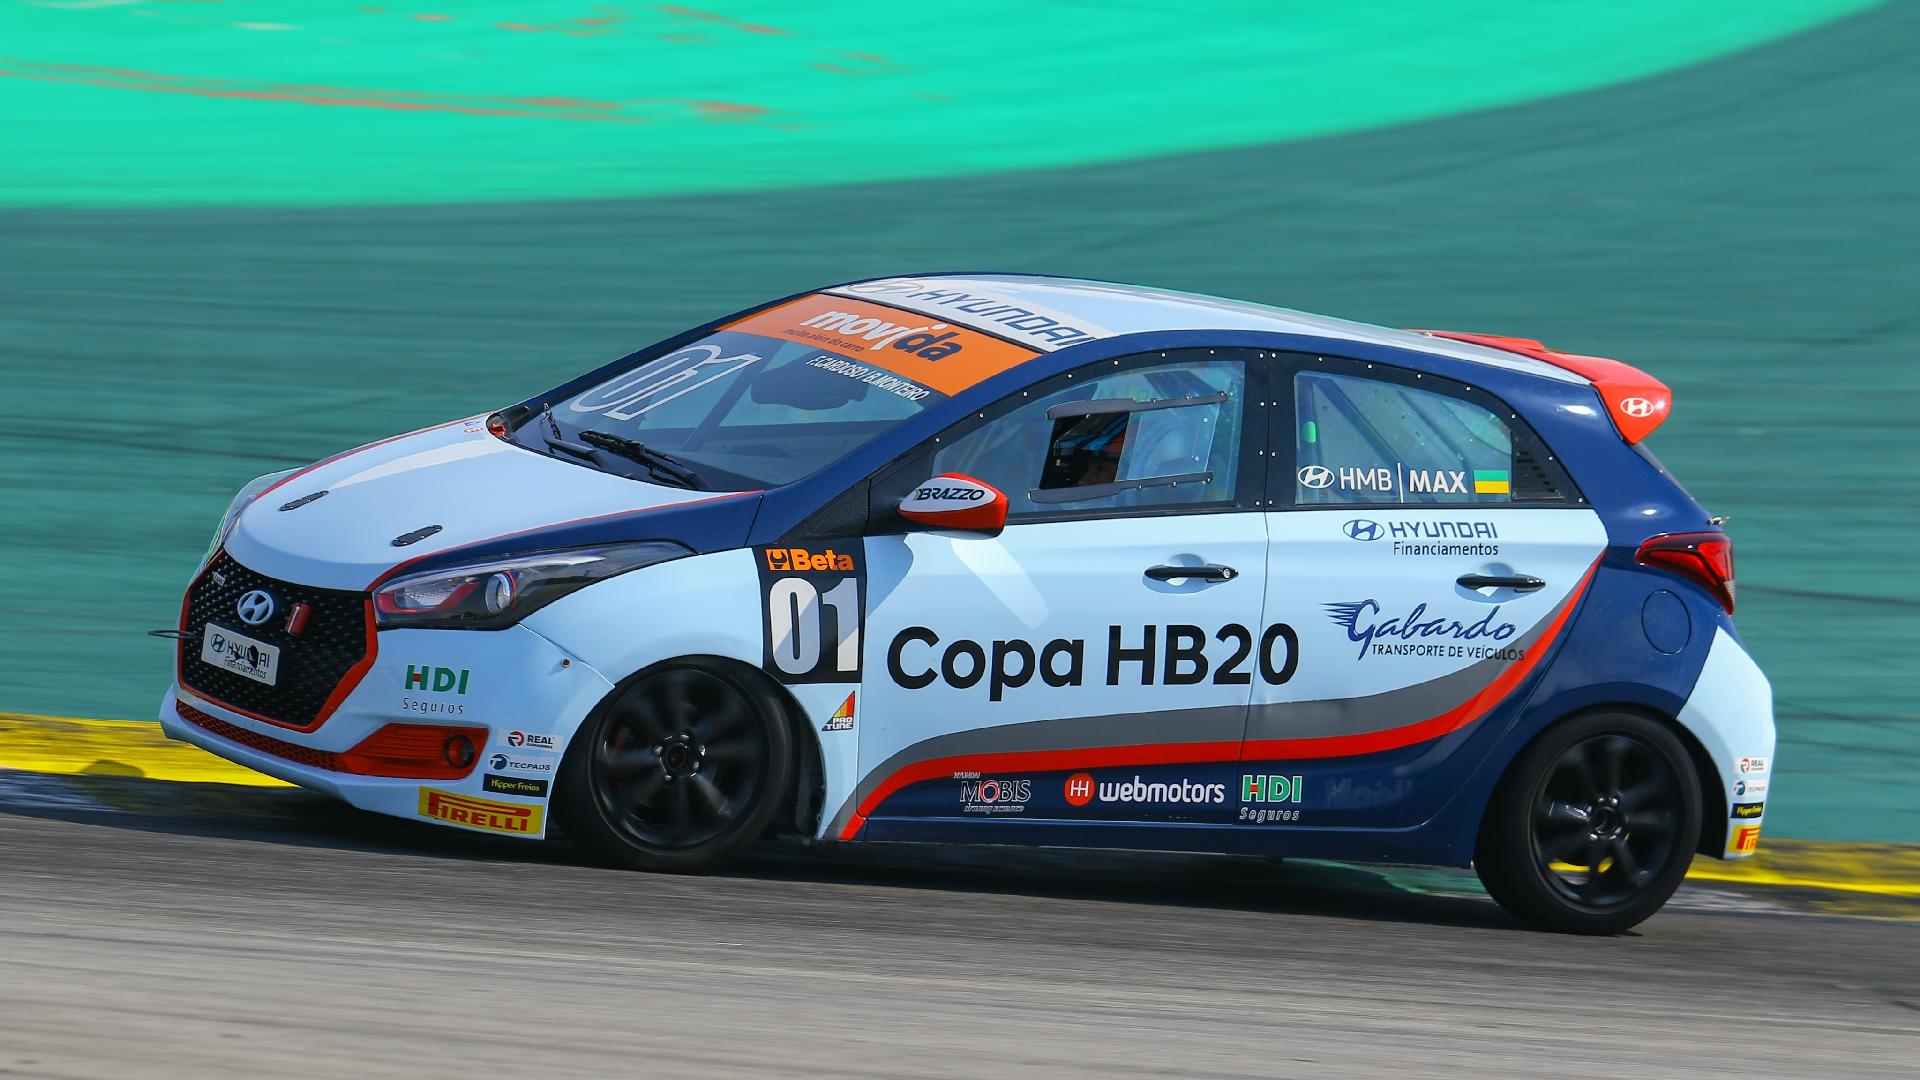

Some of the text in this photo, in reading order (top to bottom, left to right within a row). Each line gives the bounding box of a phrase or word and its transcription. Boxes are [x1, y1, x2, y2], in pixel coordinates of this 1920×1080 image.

[800, 311, 964, 362] movida
[569, 345, 763, 421] 01
[1339, 467, 1468, 494] HMB MAX
[916, 487, 985, 501] BRAZZO
[1388, 521, 1499, 539] HYUNDAI
[789, 549, 855, 571] Beta
[1393, 541, 1499, 556] Financiamentos
[769, 577, 859, 675] 01
[1320, 598, 1517, 662] Gabardo
[226, 639, 270, 668] HYUAI
[887, 622, 1299, 702] Copa HB20
[1372, 644, 1525, 661] TRANSPORTE DE VEÍCULOS
[404, 664, 470, 695] HDI
[402, 697, 464, 715] Seguros
[825, 722, 853, 730] TUNE
[832, 716, 853, 724] PRO
[527, 734, 554, 745] REAL
[509, 761, 551, 771] TECPADS
[491, 778, 515, 790] Hipper
[959, 779, 1032, 804] MOBIS
[1099, 775, 1225, 804] webmotors
[1241, 774, 1303, 804] HDI
[428, 791, 532, 832] PIRELLI
[1239, 806, 1300, 824] Seguros
